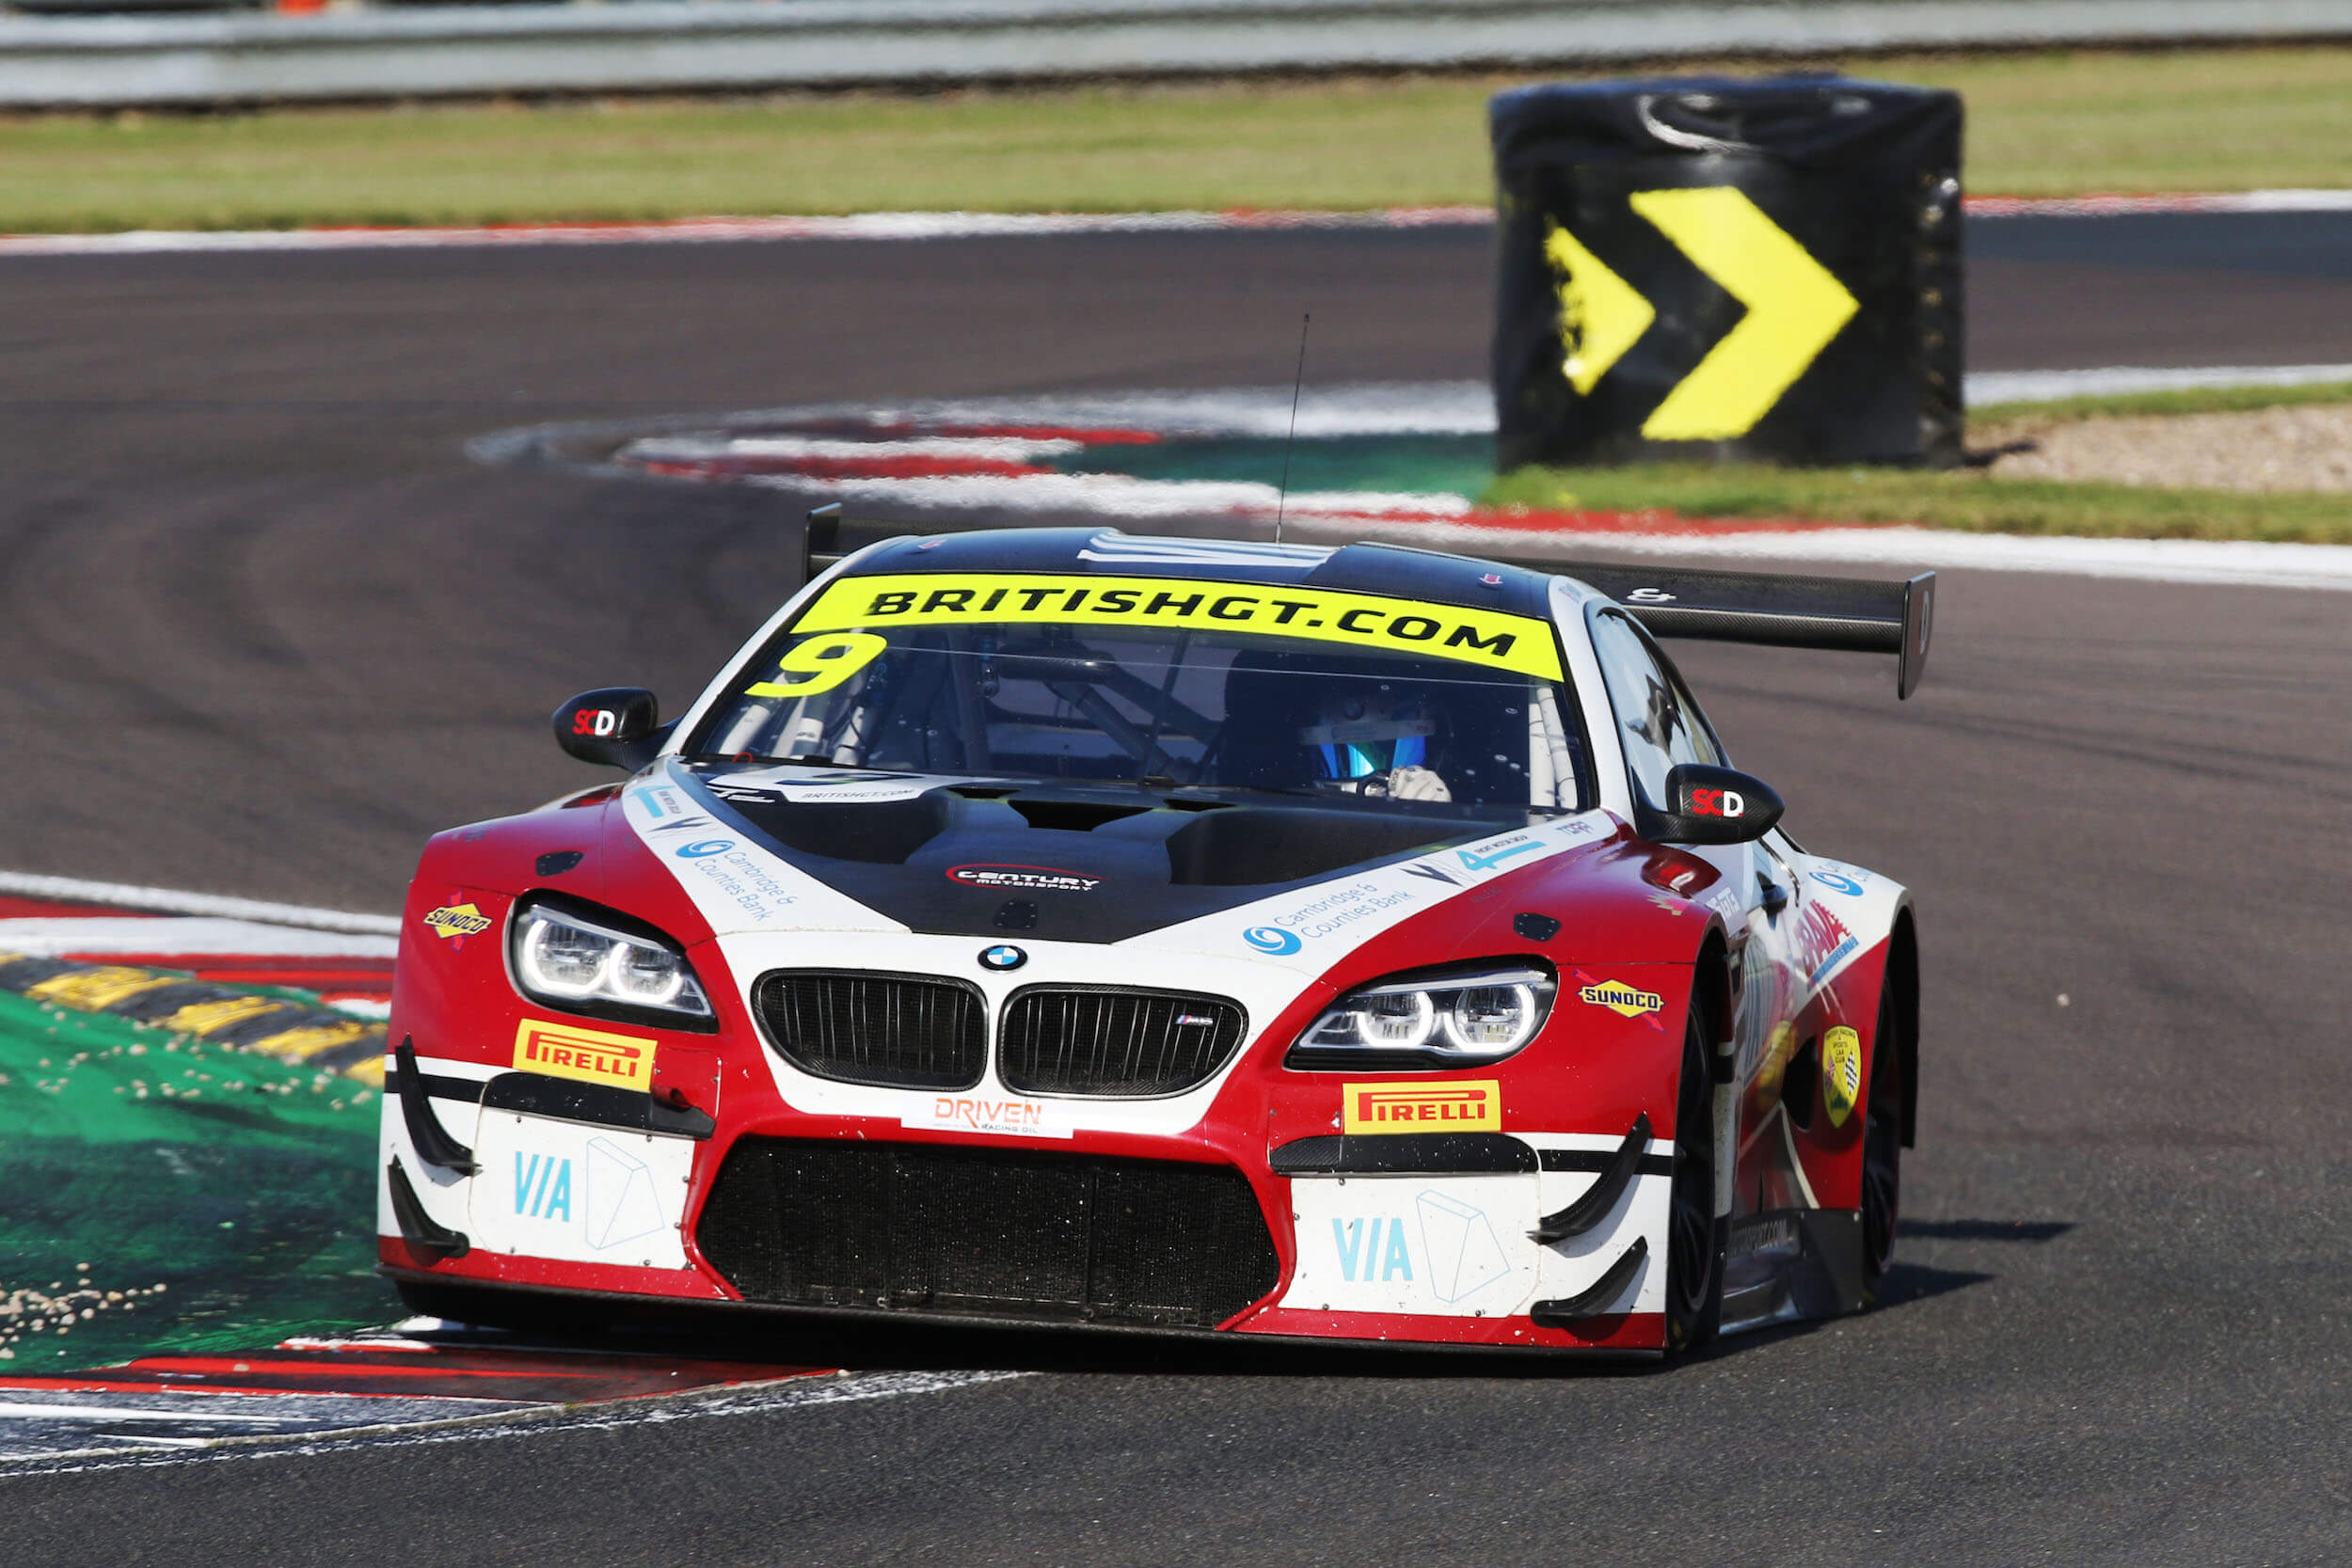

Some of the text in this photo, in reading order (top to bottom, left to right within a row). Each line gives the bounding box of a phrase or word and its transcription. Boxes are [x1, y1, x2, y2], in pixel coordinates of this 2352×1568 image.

[864, 588, 1517, 657] BRITISHGT.COM
[744, 632, 887, 698] 9
[801, 788, 914, 800] BRITISHGT.COM
[694, 858, 774, 922] Counties Bank
[724, 851, 785, 895] Cambridge
[958, 870, 1100, 887] CENTURY
[976, 879, 1093, 892] MOTORSPORT
[427, 910, 487, 932] SUNOCO
[1274, 888, 1364, 927] Cambridge
[1300, 890, 1416, 939] Counties Bank
[1584, 988, 1660, 1011] SUNOCO
[526, 1029, 641, 1079] PIRELLI
[935, 1098, 1042, 1129] DRIVEN
[1358, 1089, 1486, 1122] PIRELLI
